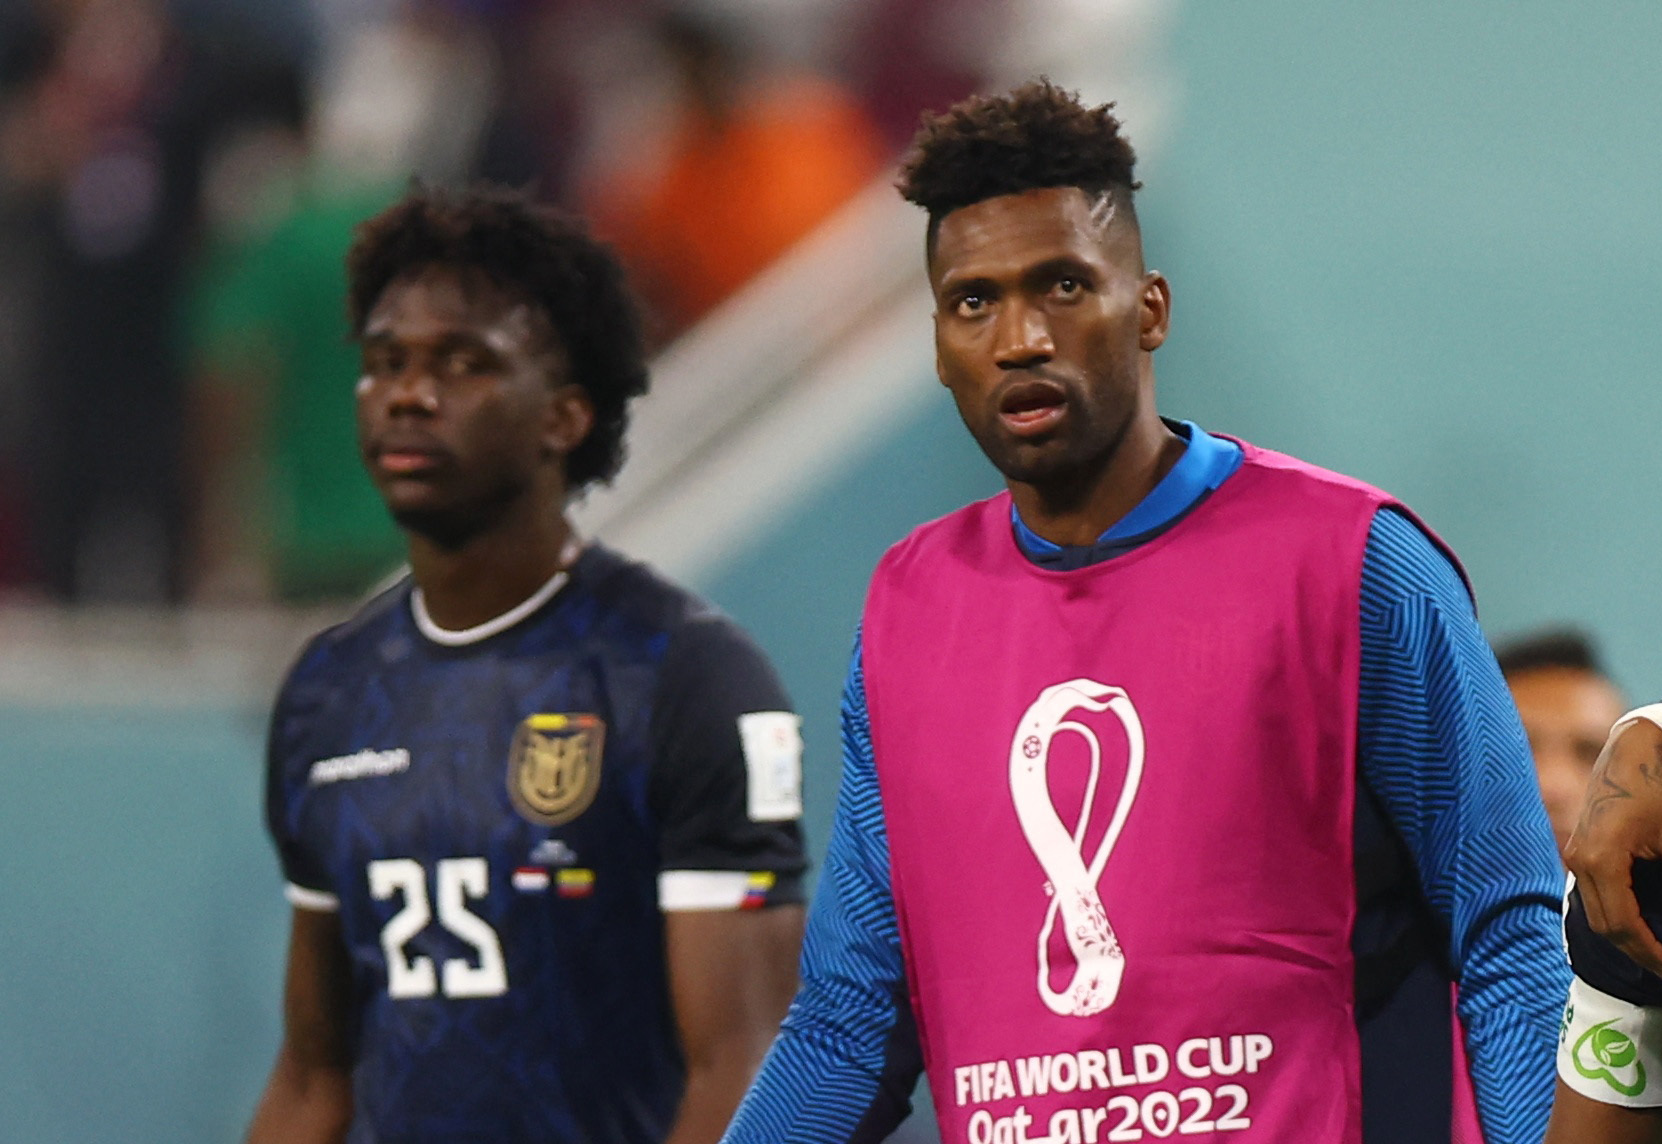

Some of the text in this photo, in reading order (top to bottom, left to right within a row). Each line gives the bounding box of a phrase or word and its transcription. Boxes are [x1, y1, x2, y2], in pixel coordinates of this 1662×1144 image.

[367, 857, 508, 998] 25
[954, 1033, 1274, 1107] FIFA WORLD CUP
